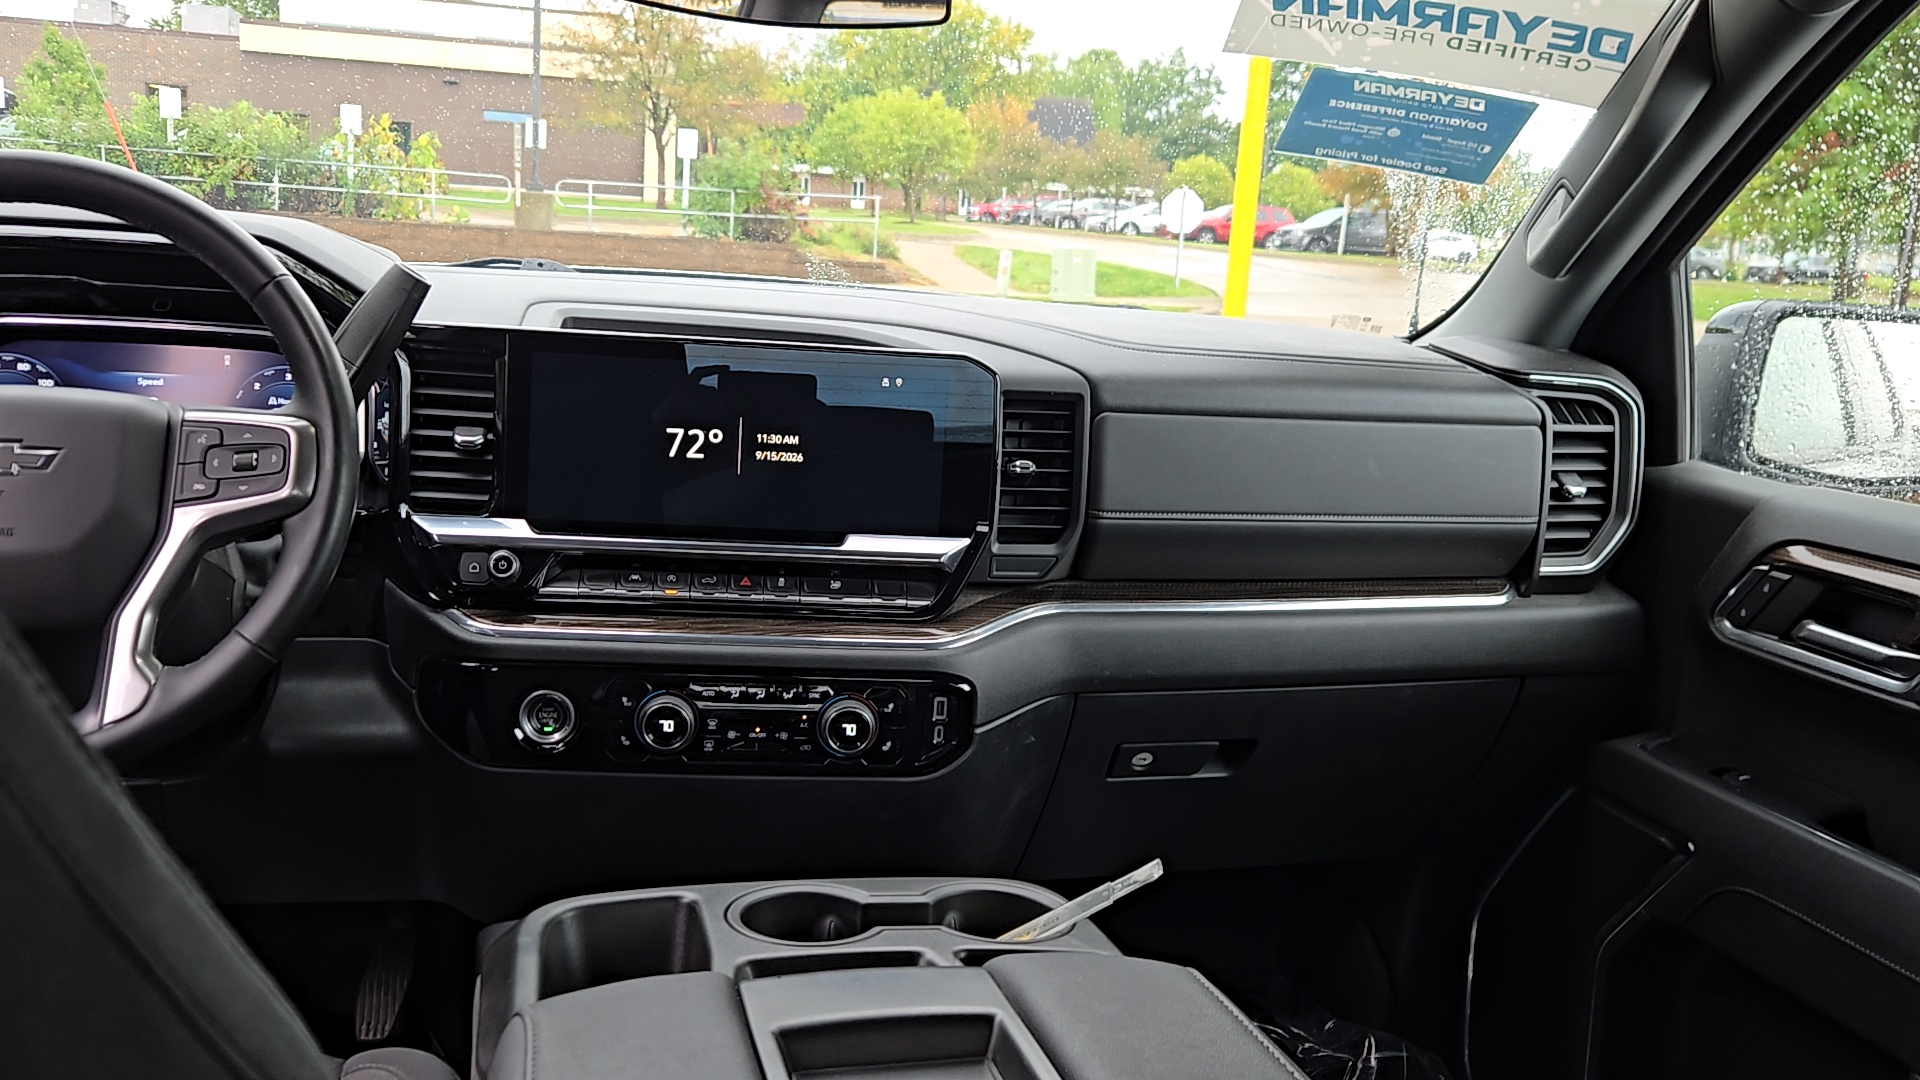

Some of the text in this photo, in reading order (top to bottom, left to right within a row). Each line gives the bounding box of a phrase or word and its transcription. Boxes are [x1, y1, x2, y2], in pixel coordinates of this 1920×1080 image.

[37, 378, 55, 387] 100
[136, 376, 165, 388] Speed
[756, 433, 799, 446] 11:30 AM
[755, 450, 804, 464] 9/15/2026
